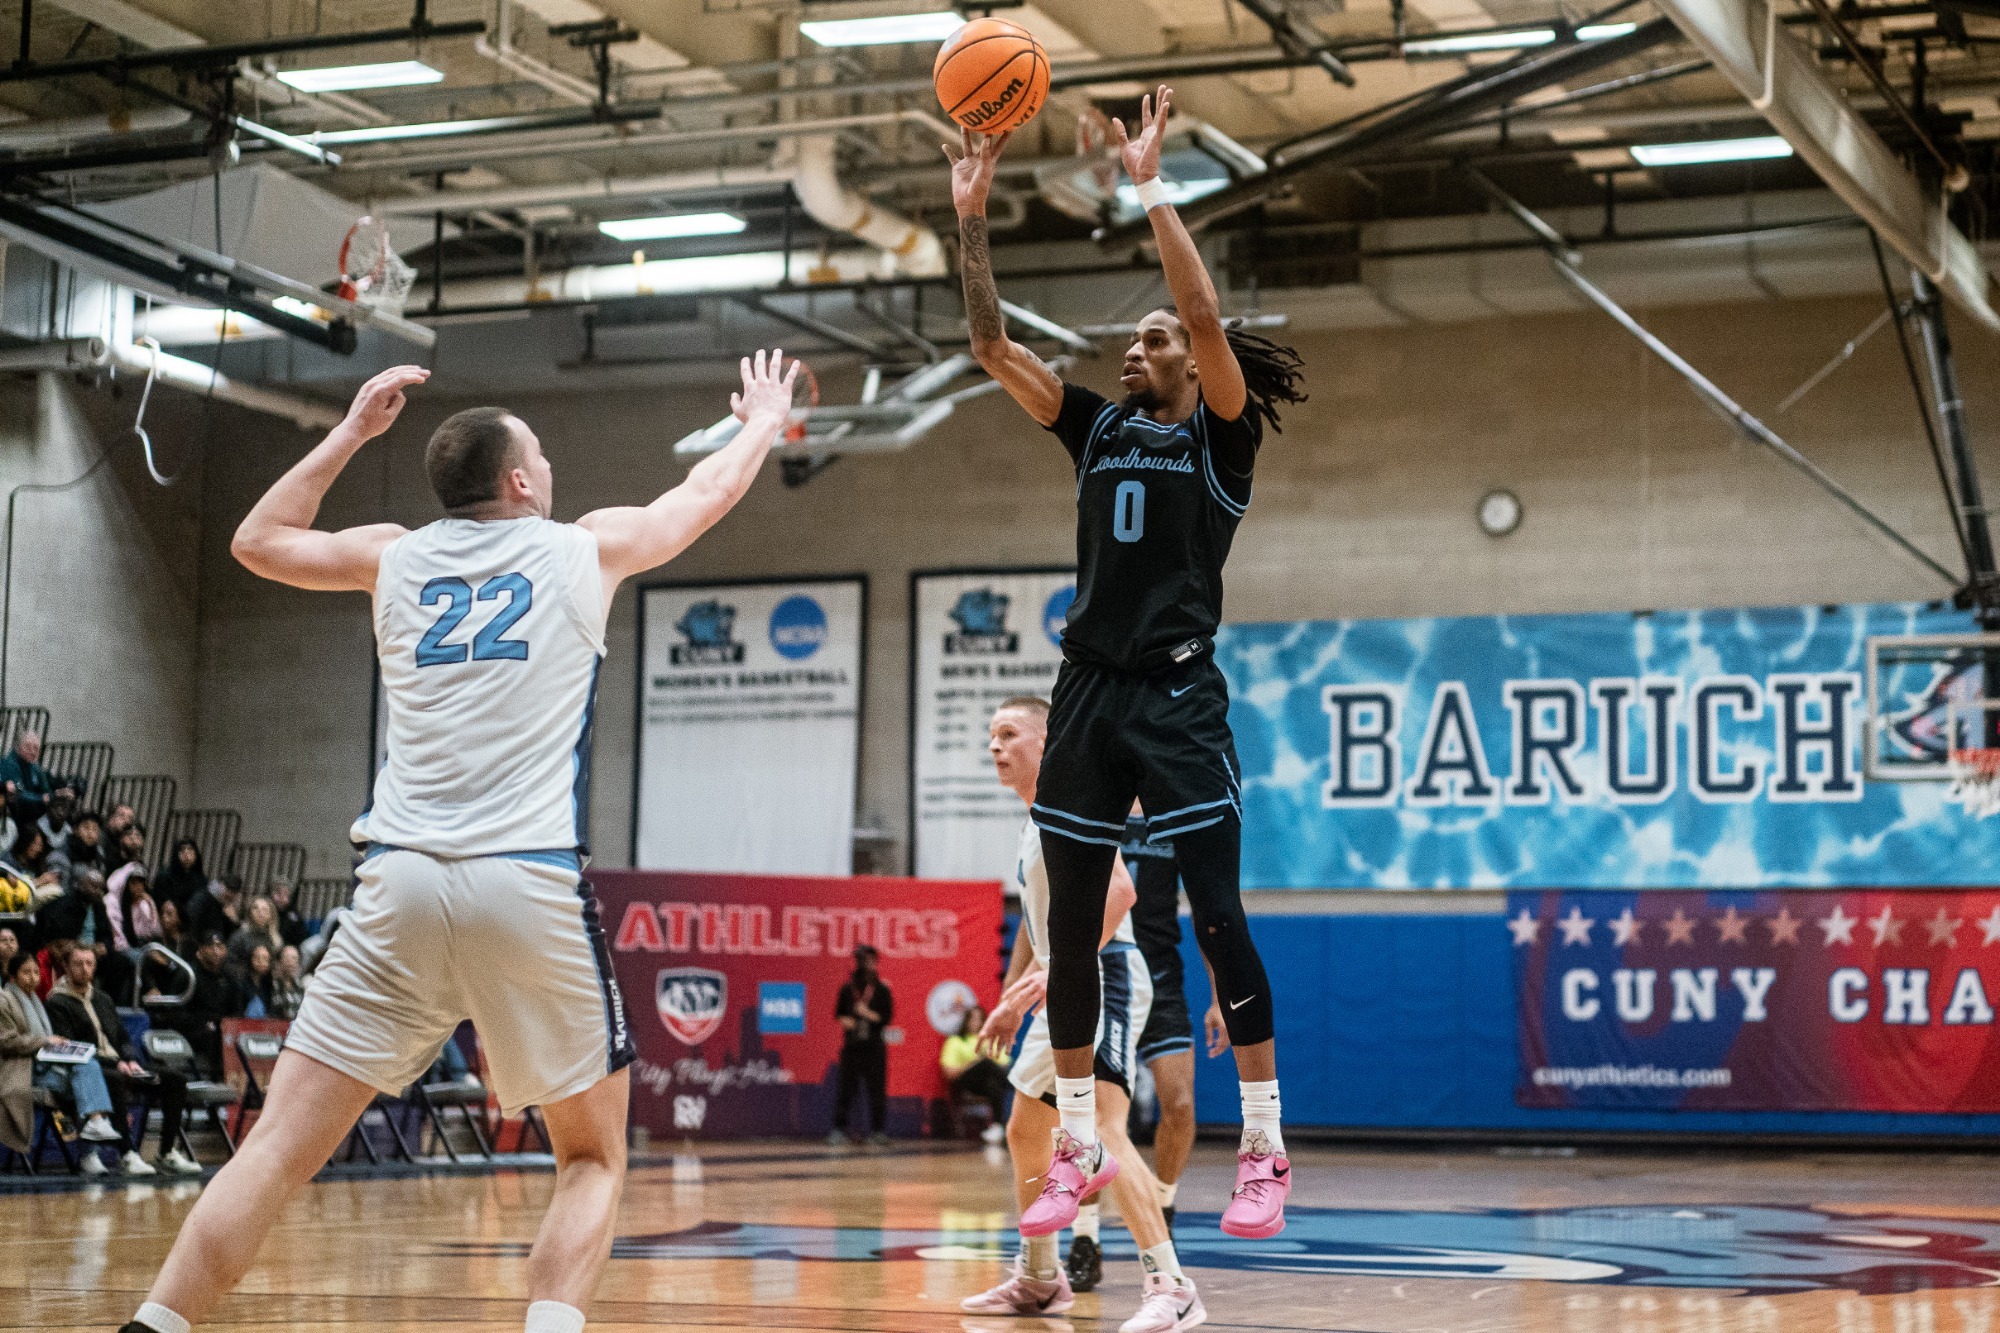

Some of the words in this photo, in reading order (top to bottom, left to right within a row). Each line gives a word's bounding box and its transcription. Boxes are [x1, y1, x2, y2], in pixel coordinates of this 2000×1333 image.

[958, 78, 1024, 127] Wilson
[1113, 480, 1145, 543] 0
[415, 572, 533, 668] 22
[653, 671, 732, 689] WOMEN'S
[736, 667, 849, 687] BASKETBALL
[1323, 673, 1863, 807] BARUCH
[614, 901, 960, 959] ATHLETICS
[1561, 967, 1776, 1023] CUNY
[1532, 1063, 1733, 1090] cunyathletics.com
